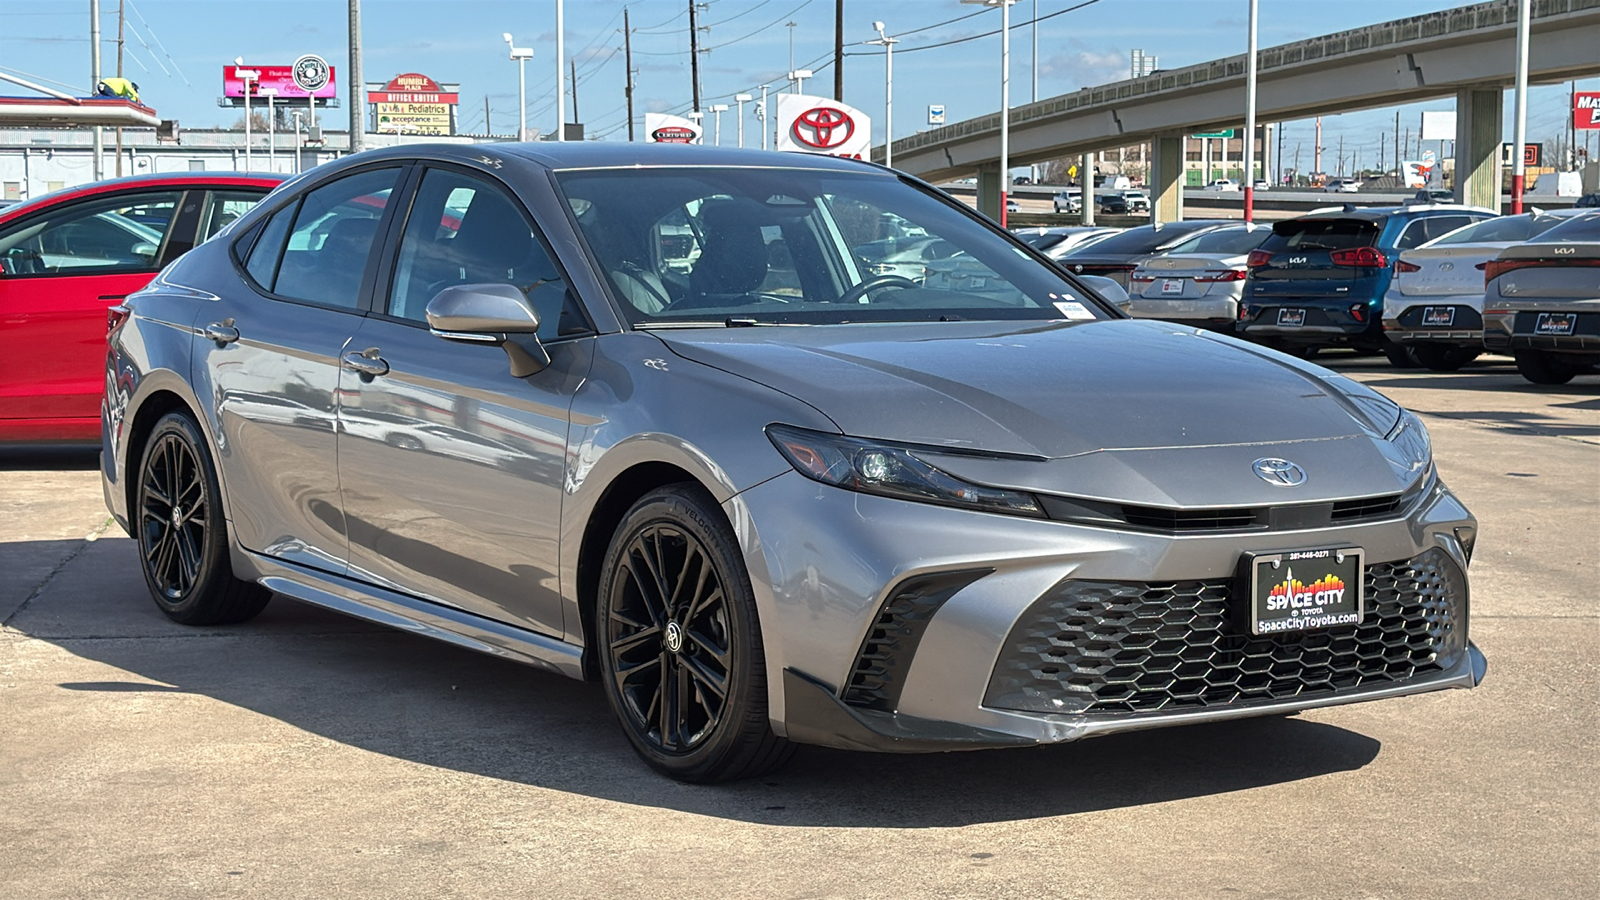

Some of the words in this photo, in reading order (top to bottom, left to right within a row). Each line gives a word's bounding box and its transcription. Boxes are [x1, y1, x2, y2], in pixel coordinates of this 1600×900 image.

[397, 78, 428, 86] HUMBLE
[387, 93, 412, 103] OFFICE
[413, 94, 439, 103] SUITES
[408, 104, 446, 114] Pediatrics
[391, 116, 431, 124] acceptance
[1266, 592, 1312, 610] SPACE
[1315, 588, 1345, 606] CITY
[1301, 607, 1324, 617] TOYOTA
[1258, 613, 1358, 634] SpaceCityToyota.com
